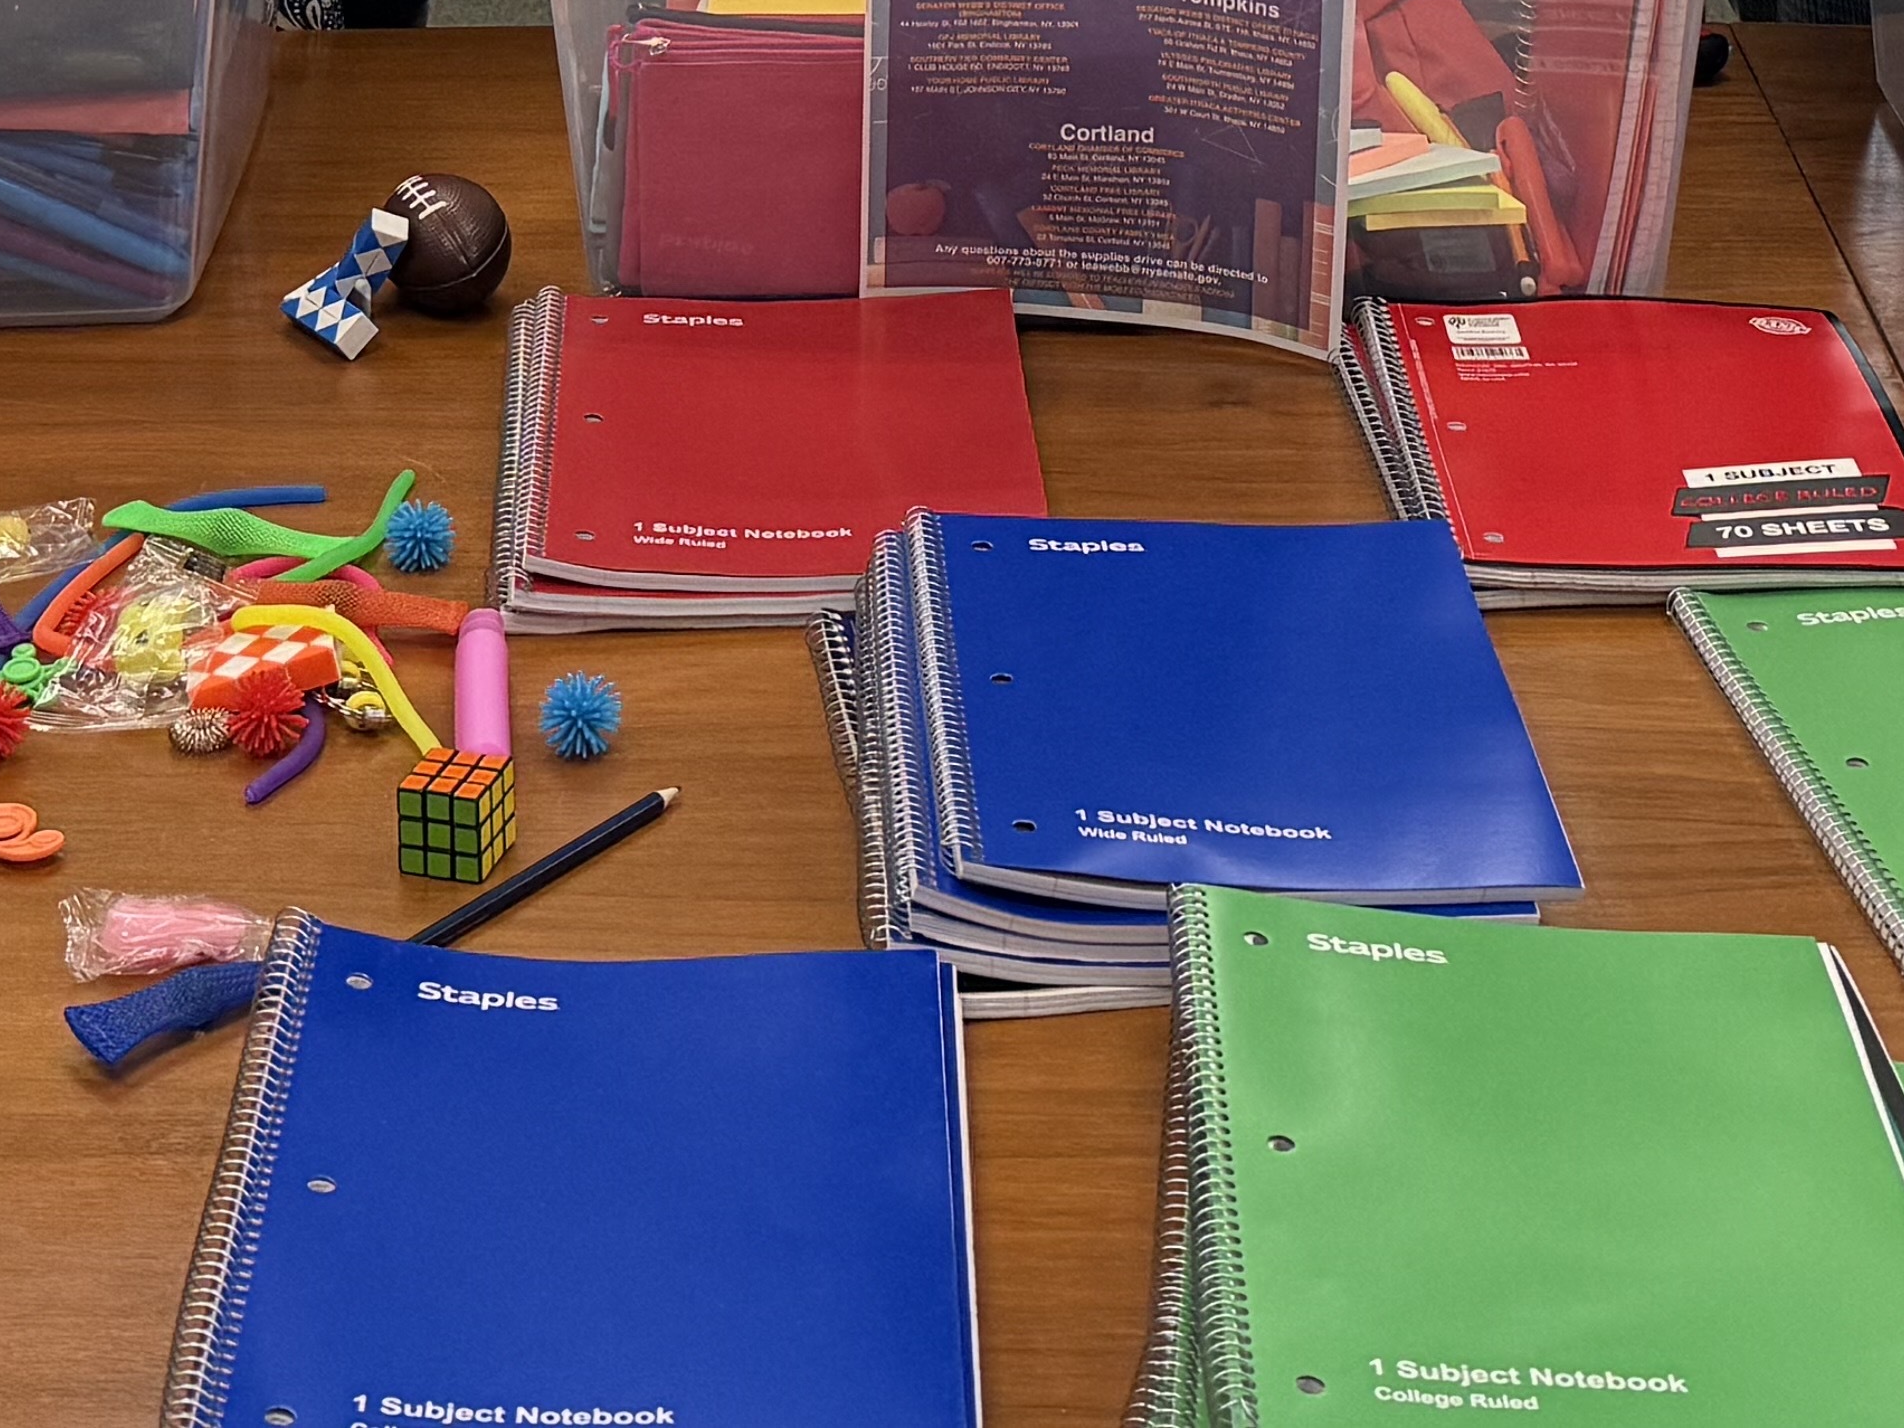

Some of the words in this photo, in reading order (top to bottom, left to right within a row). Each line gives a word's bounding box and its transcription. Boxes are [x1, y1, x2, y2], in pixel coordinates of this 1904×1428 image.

[1060, 123, 1155, 143] Cortland
[935, 243, 959, 255] Any
[961, 245, 1019, 258] questions
[1022, 246, 1056, 258] about
[1058, 247, 1078, 259] the
[1081, 250, 1131, 264] supplies
[1134, 253, 1163, 265] drive
[1166, 258, 1187, 269] can
[1191, 259, 1205, 270] be
[1208, 263, 1254, 281] directed
[1256, 272, 1268, 284] to
[1066, 260, 1078, 269] or
[642, 312, 744, 328] Staples
[1705, 470, 1715, 482] 1
[1724, 460, 1836, 483] SUBJECT
[1678, 488, 1788, 510] COLLEGE
[1792, 483, 1878, 503] RULED
[633, 521, 643, 533] 1
[652, 523, 737, 540] Subject
[743, 525, 853, 540] Notebook
[1716, 522, 1753, 541] 70
[1761, 516, 1890, 538] SHEETS
[632, 535, 674, 546] Wide
[678, 537, 726, 548] Ruled
[1028, 538, 1145, 555] Staples
[1075, 808, 1087, 821] 1
[1097, 808, 1198, 831] Subject
[1204, 818, 1333, 840] Notebook
[1077, 825, 1126, 840] Wide
[1132, 830, 1187, 846] Ruled
[1306, 933, 1448, 966] Staples
[417, 982, 560, 1013] Staples
[1368, 1358, 1384, 1377] 1
[1396, 1360, 1522, 1388] Subject
[1530, 1368, 1689, 1394] Notebook
[352, 1395, 366, 1415] 1
[380, 1397, 506, 1427] Subject
[515, 1406, 675, 1427] Notebook
[1374, 1387, 1464, 1411] College
[1469, 1394, 1539, 1412] Ruled
